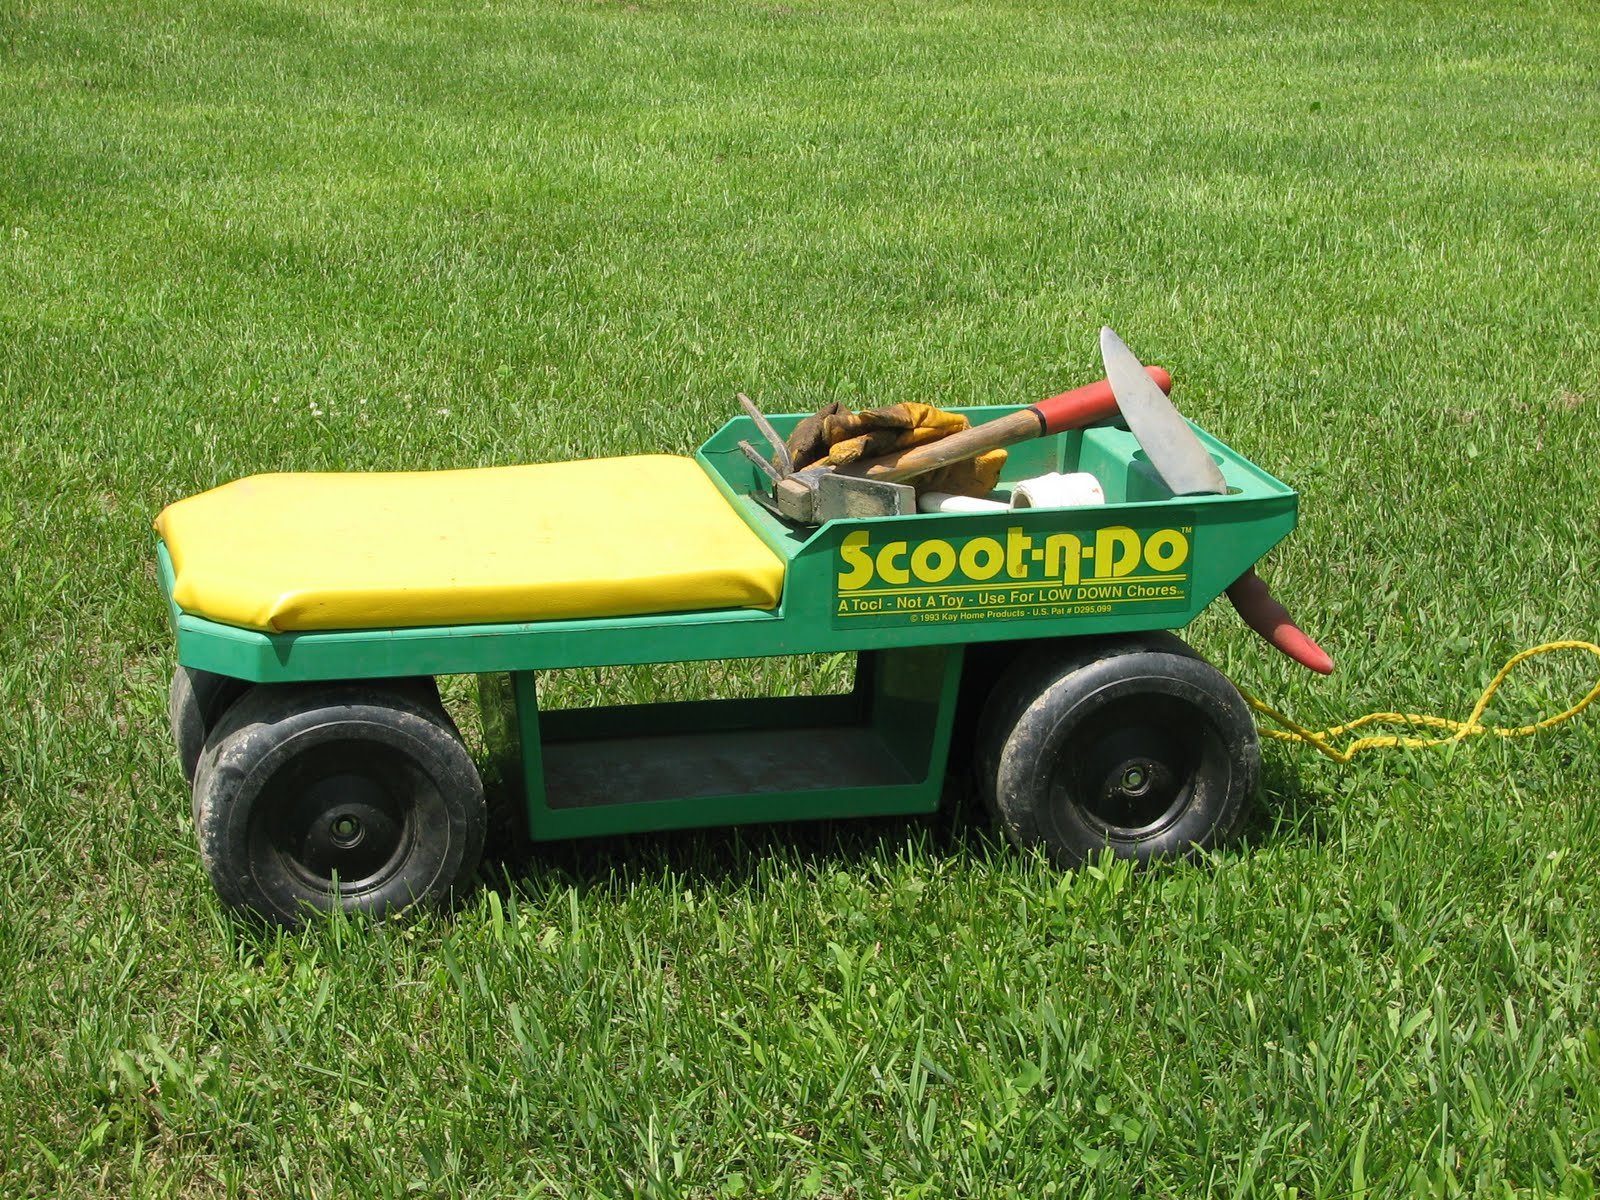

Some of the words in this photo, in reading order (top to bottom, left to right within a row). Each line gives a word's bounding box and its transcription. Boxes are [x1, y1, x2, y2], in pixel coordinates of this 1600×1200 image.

[838, 600, 848, 611] A
[897, 597, 922, 608] Not
[926, 596, 936, 607] A
[939, 595, 964, 608] Toy
[978, 593, 1005, 604] Use
[1011, 592, 1034, 602] For
[1039, 589, 1072, 601] LOW
[1077, 587, 1122, 599] DOWN
[1127, 585, 1177, 597] Chores
[942, 613, 958, 621] Kay
[987, 610, 1025, 618] Products
[1032, 608, 1049, 616] U.S.
